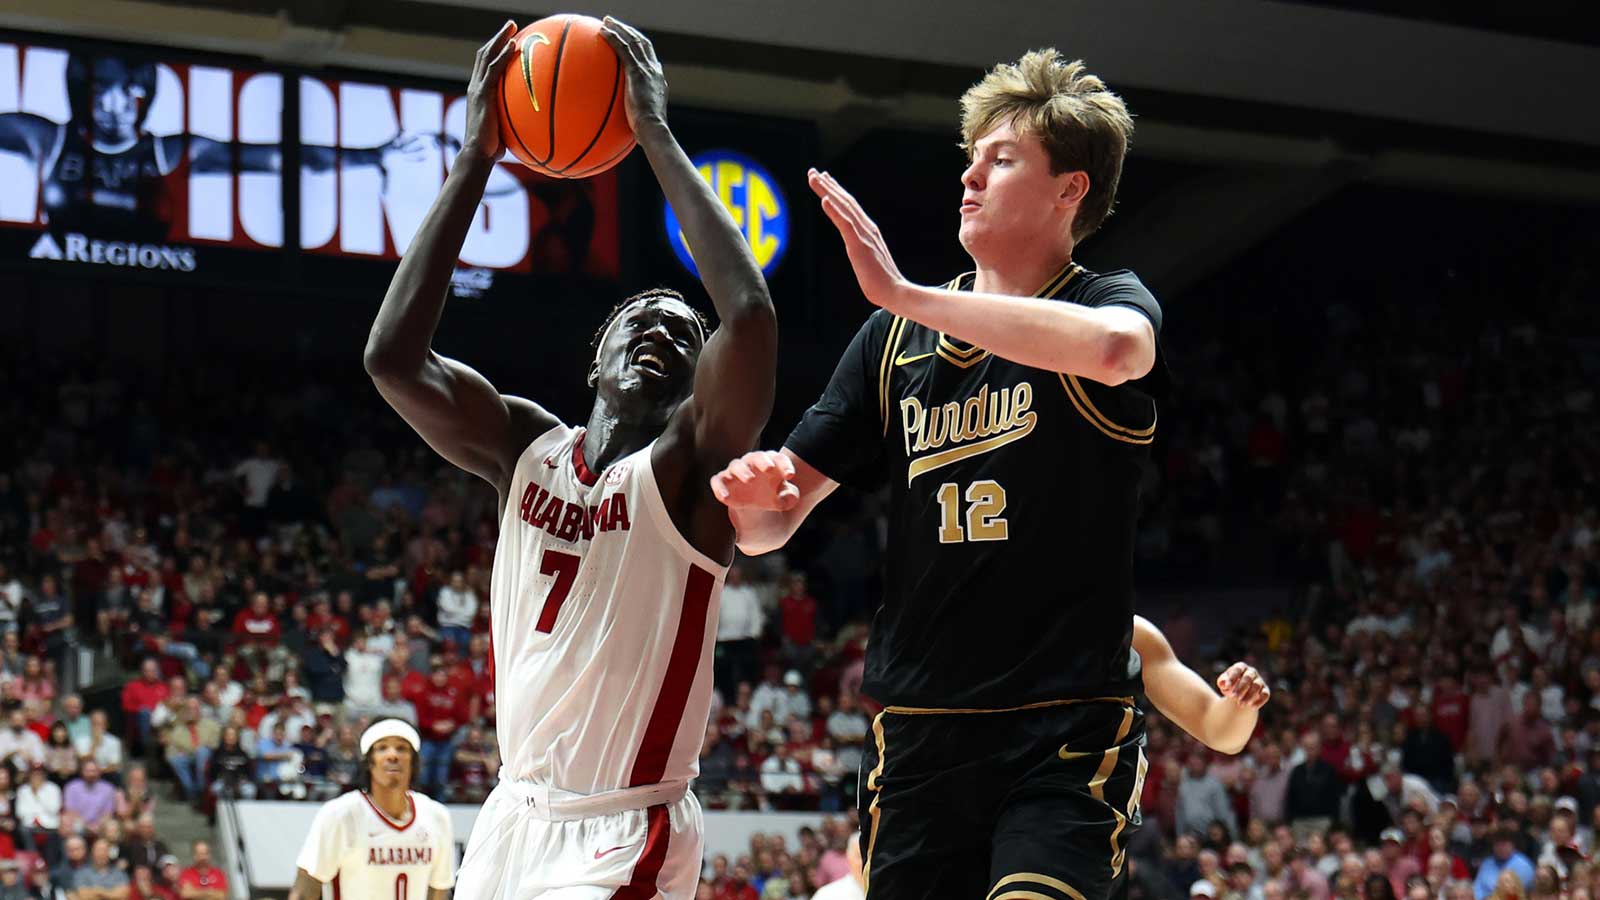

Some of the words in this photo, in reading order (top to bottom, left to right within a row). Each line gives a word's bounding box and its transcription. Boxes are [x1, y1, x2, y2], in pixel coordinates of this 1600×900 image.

[679, 160, 781, 270] EC
[65, 232, 197, 272] REGIONS
[900, 381, 1036, 457] Purdue
[520, 481, 631, 543] ALABAMA
[937, 479, 1008, 543] 12
[535, 549, 581, 634] 7
